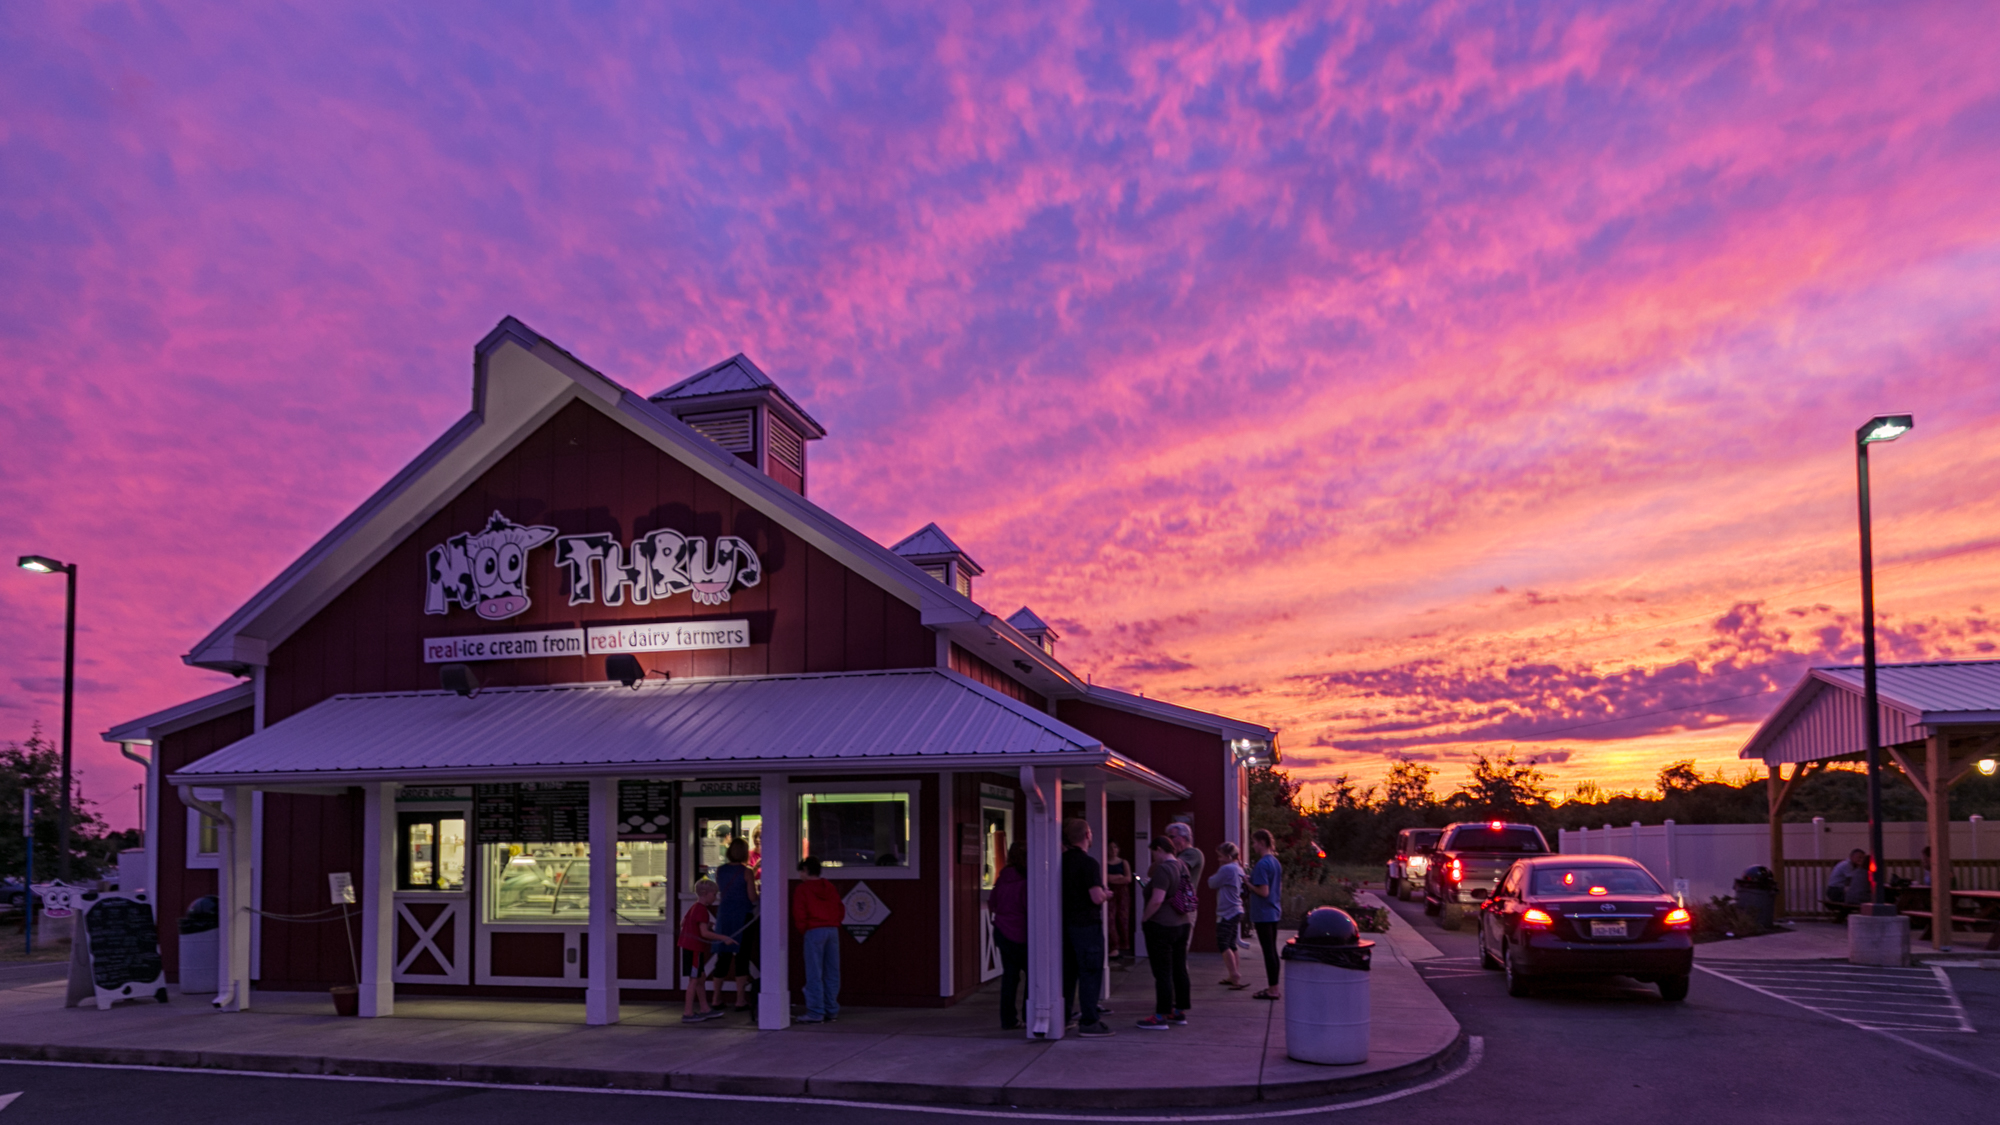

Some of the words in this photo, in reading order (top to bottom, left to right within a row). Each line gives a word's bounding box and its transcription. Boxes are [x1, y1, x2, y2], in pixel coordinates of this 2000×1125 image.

[424, 513, 553, 620] MOO
[555, 528, 760, 606] THRU
[489, 638, 538, 656] cream
[542, 634, 580, 653] from
[628, 628, 670, 647] dairy
[675, 626, 744, 647] farmers
[433, 787, 455, 798] HERE
[700, 782, 733, 793] ORDER
